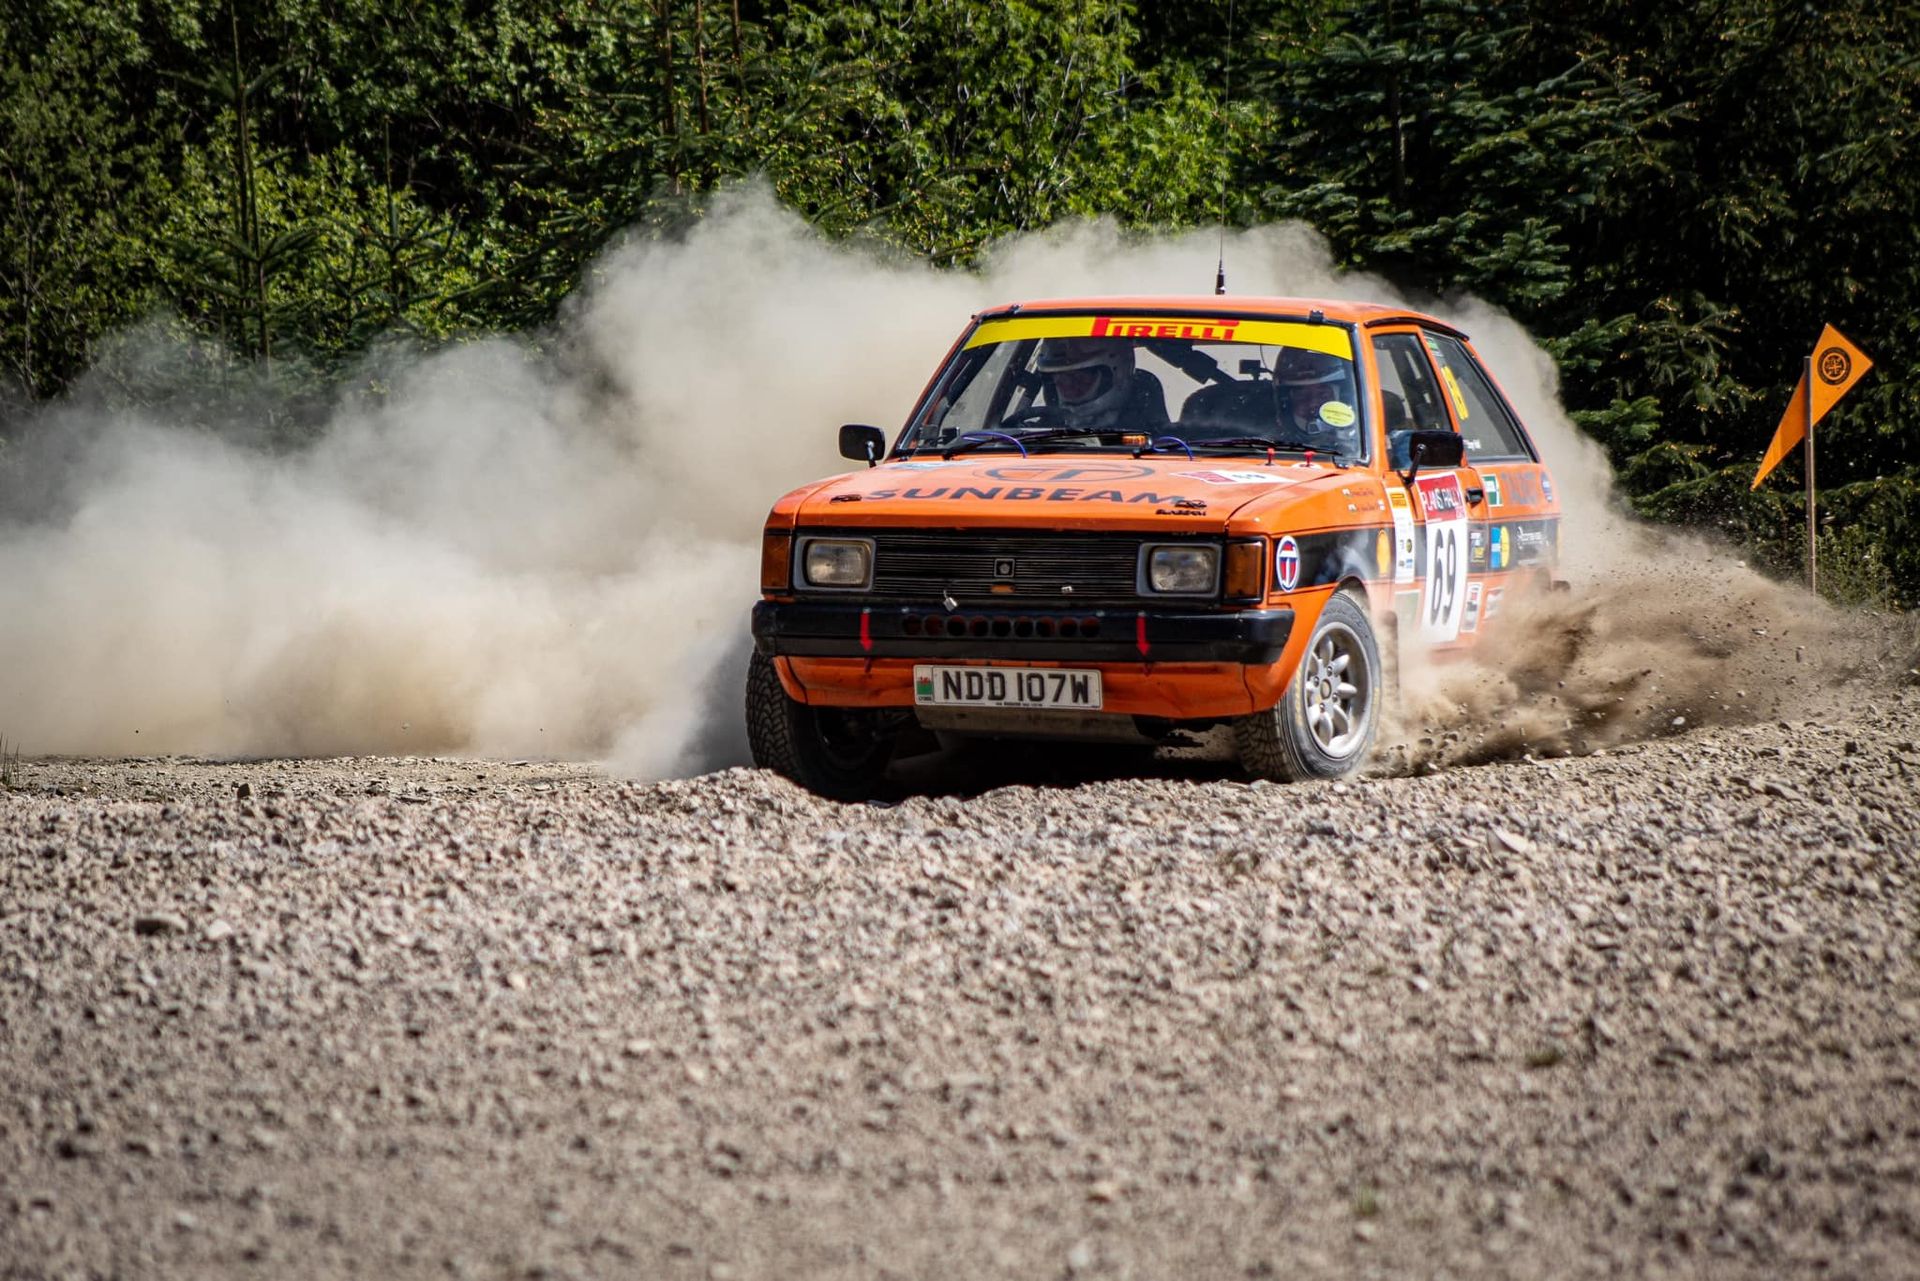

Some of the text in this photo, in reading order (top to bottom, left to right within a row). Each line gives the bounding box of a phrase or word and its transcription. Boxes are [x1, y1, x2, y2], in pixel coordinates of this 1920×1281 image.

[1091, 317, 1240, 341] PIRELLI
[865, 487, 1185, 504] SUNBEAM
[1430, 528, 1457, 626] 69
[942, 670, 1090, 704] NDD 107W
